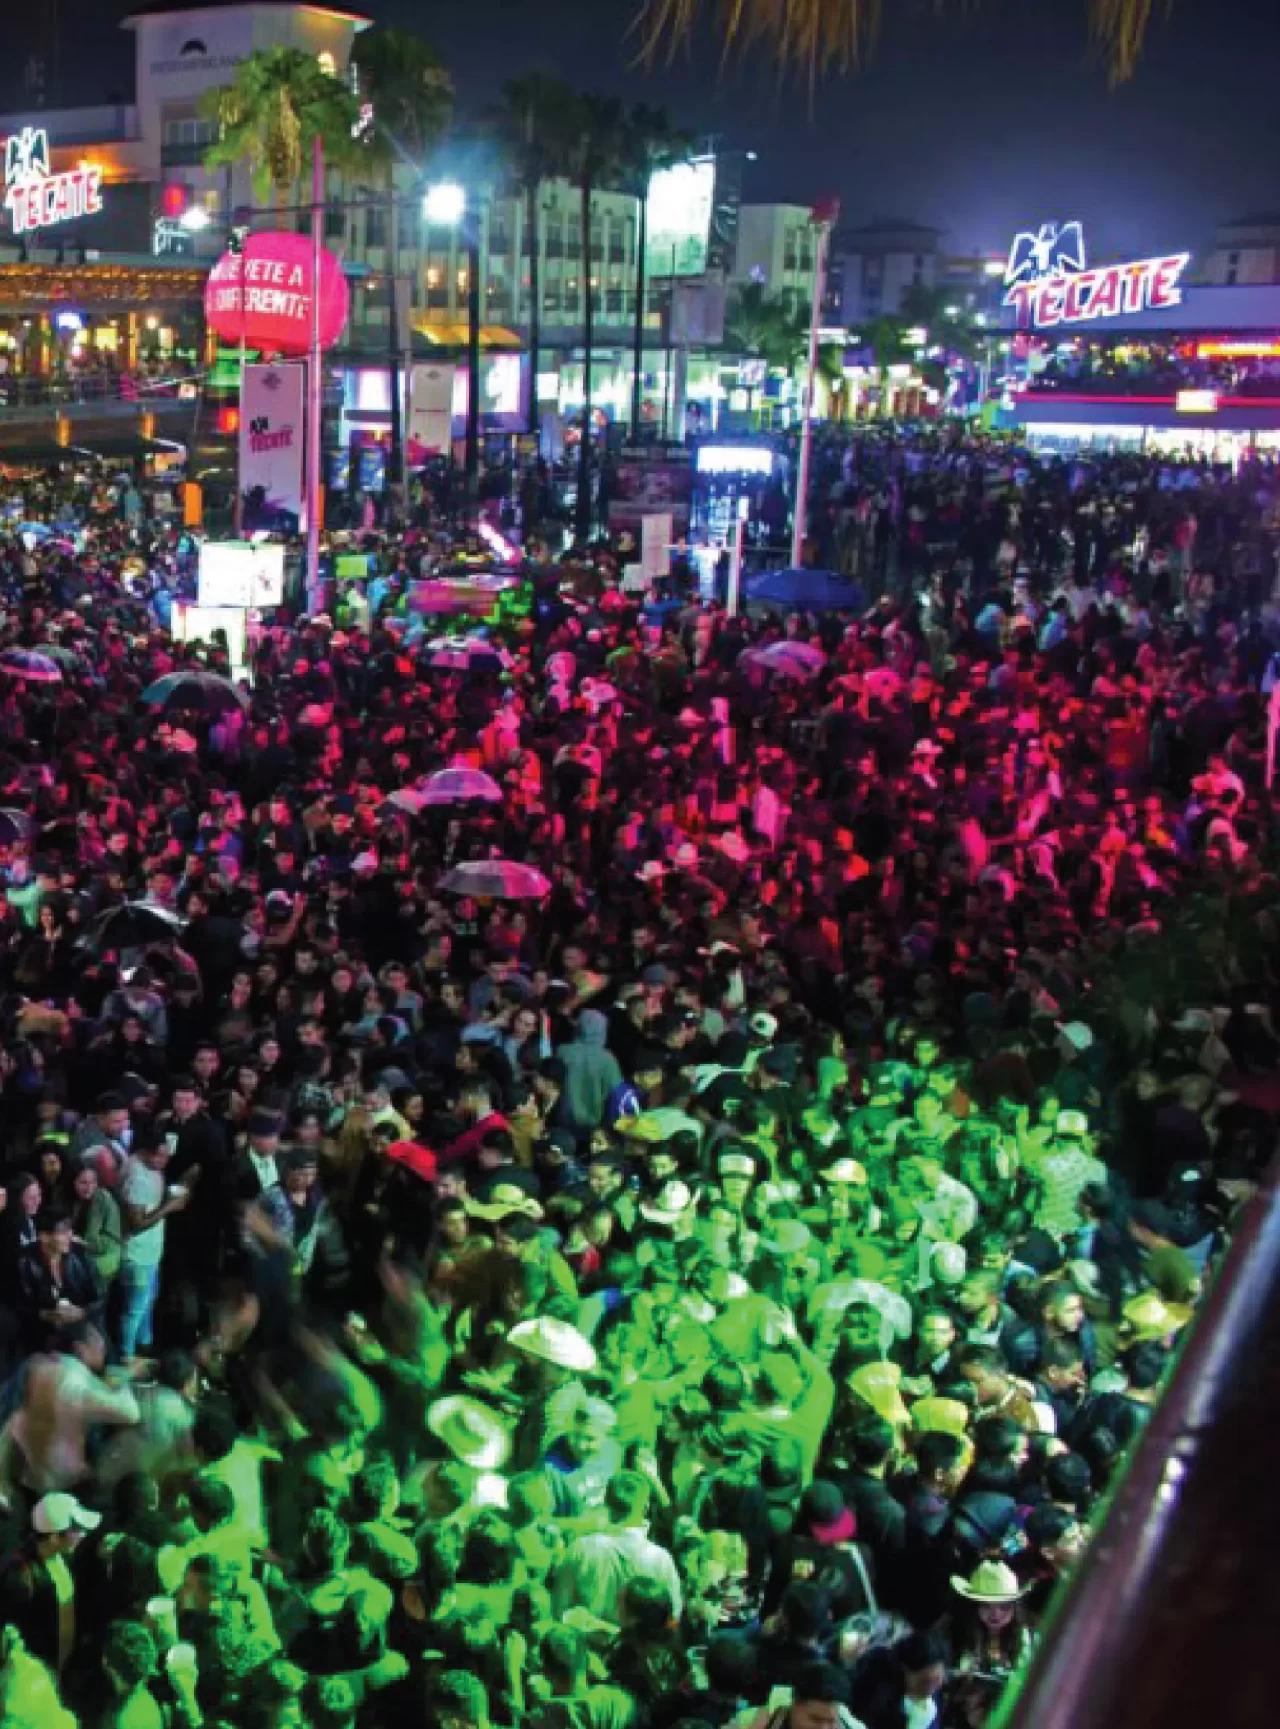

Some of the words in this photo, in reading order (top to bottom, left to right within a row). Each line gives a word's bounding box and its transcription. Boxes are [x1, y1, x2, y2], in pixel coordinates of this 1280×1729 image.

[5, 164, 102, 233] TECATE
[288, 264, 303, 286] A
[1003, 252, 1189, 328] TECATE
